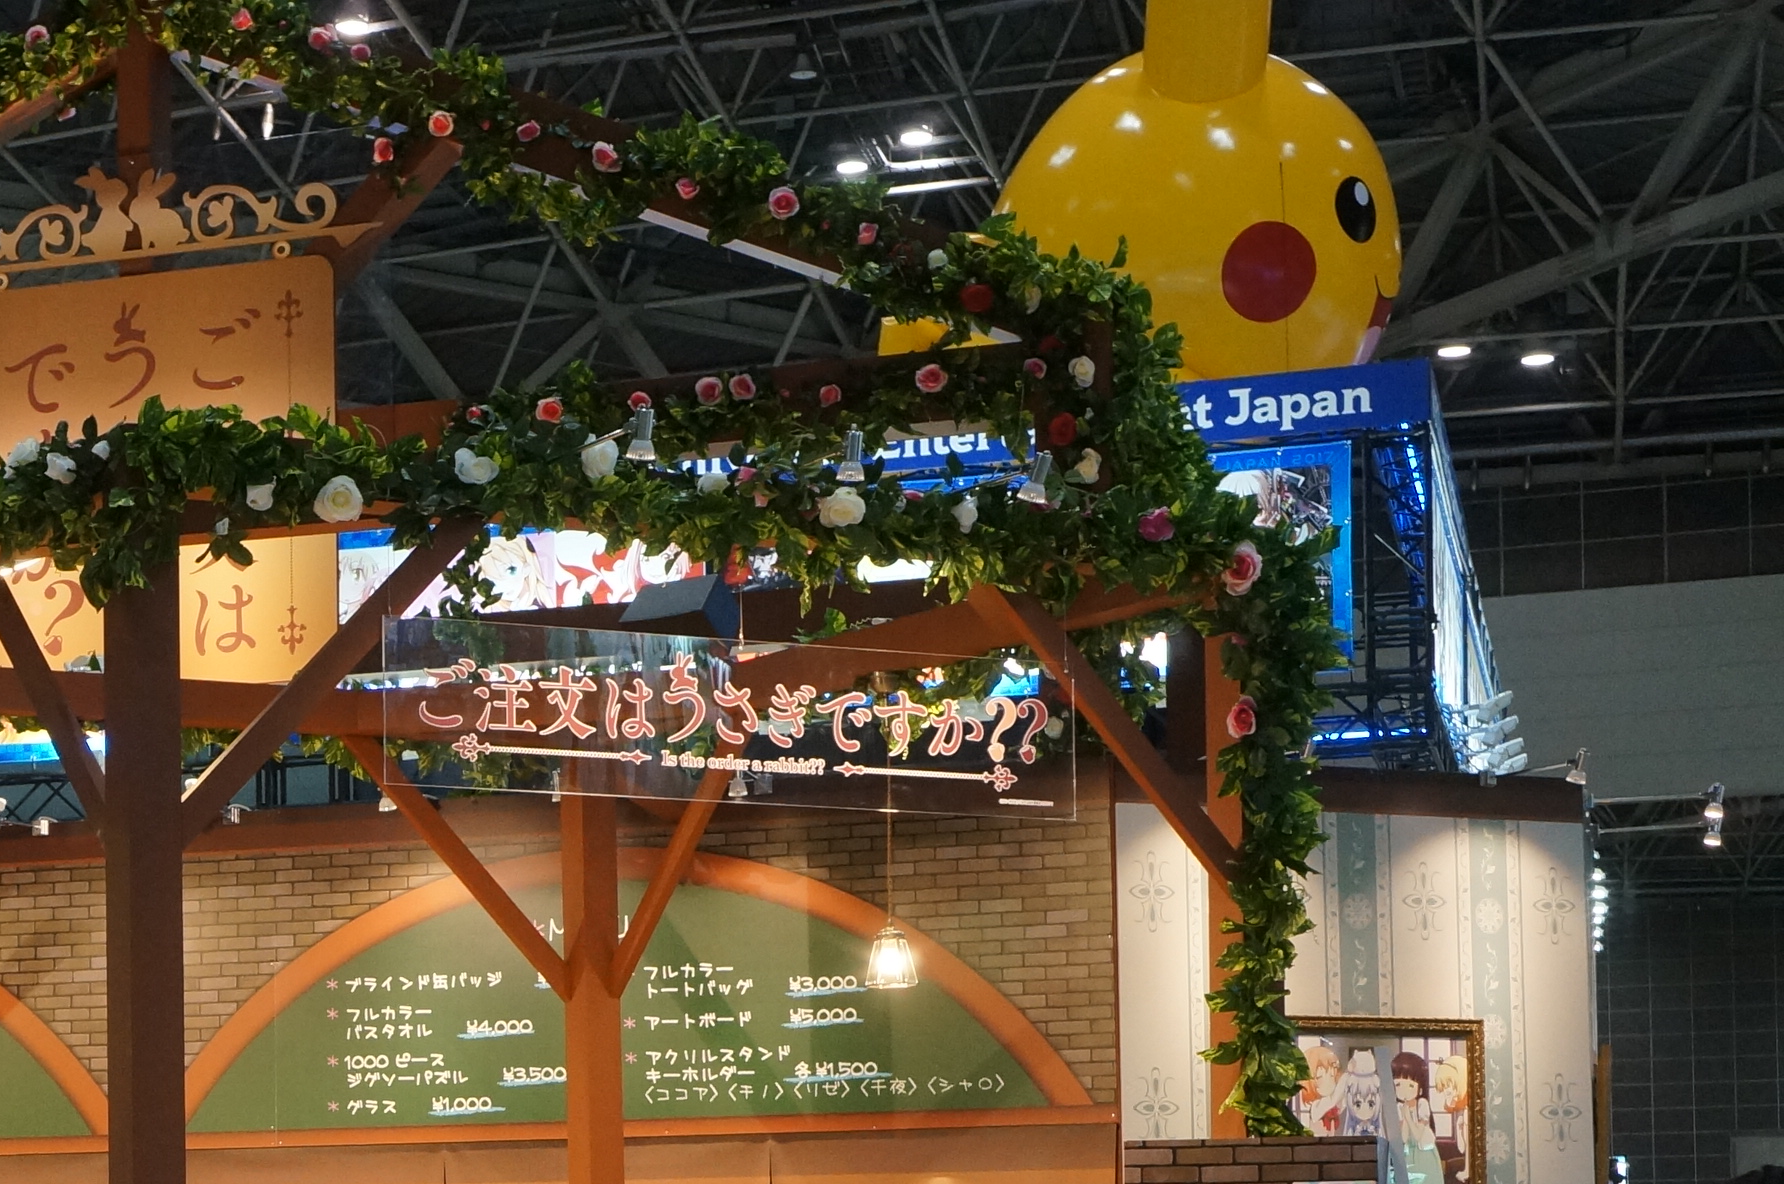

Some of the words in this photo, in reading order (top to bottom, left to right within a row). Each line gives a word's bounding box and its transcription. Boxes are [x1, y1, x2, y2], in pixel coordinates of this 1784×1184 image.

[1225, 386, 1373, 432] Japan
[419, 653, 1048, 764] ご注文はうさぎですか??
[661, 750, 677, 767] Is
[680, 751, 705, 768] the
[707, 754, 750, 770] order
[752, 759, 762, 772] a
[764, 757, 825, 775] rabbit??
[643, 962, 734, 979] フルカラー
[345, 971, 502, 993] ブラインド缶バッジ
[645, 978, 753, 998] トートバッグ
[789, 974, 857, 992] ¥3,000
[346, 1005, 432, 1022] フルカラー
[643, 1011, 752, 1030] アートボード
[789, 1007, 858, 1025] ¥5,000
[346, 1023, 433, 1040] バスタオル
[466, 1019, 533, 1036] ¥4,000
[645, 1045, 791, 1066] アクリルスタンド
[346, 1070, 468, 1088] ジグソーパズル
[502, 1066, 566, 1084] ¥3,500
[645, 1066, 755, 1084] キーホルダー
[346, 1099, 397, 1115] グラス
[432, 1096, 492, 1113] ¥1,000
